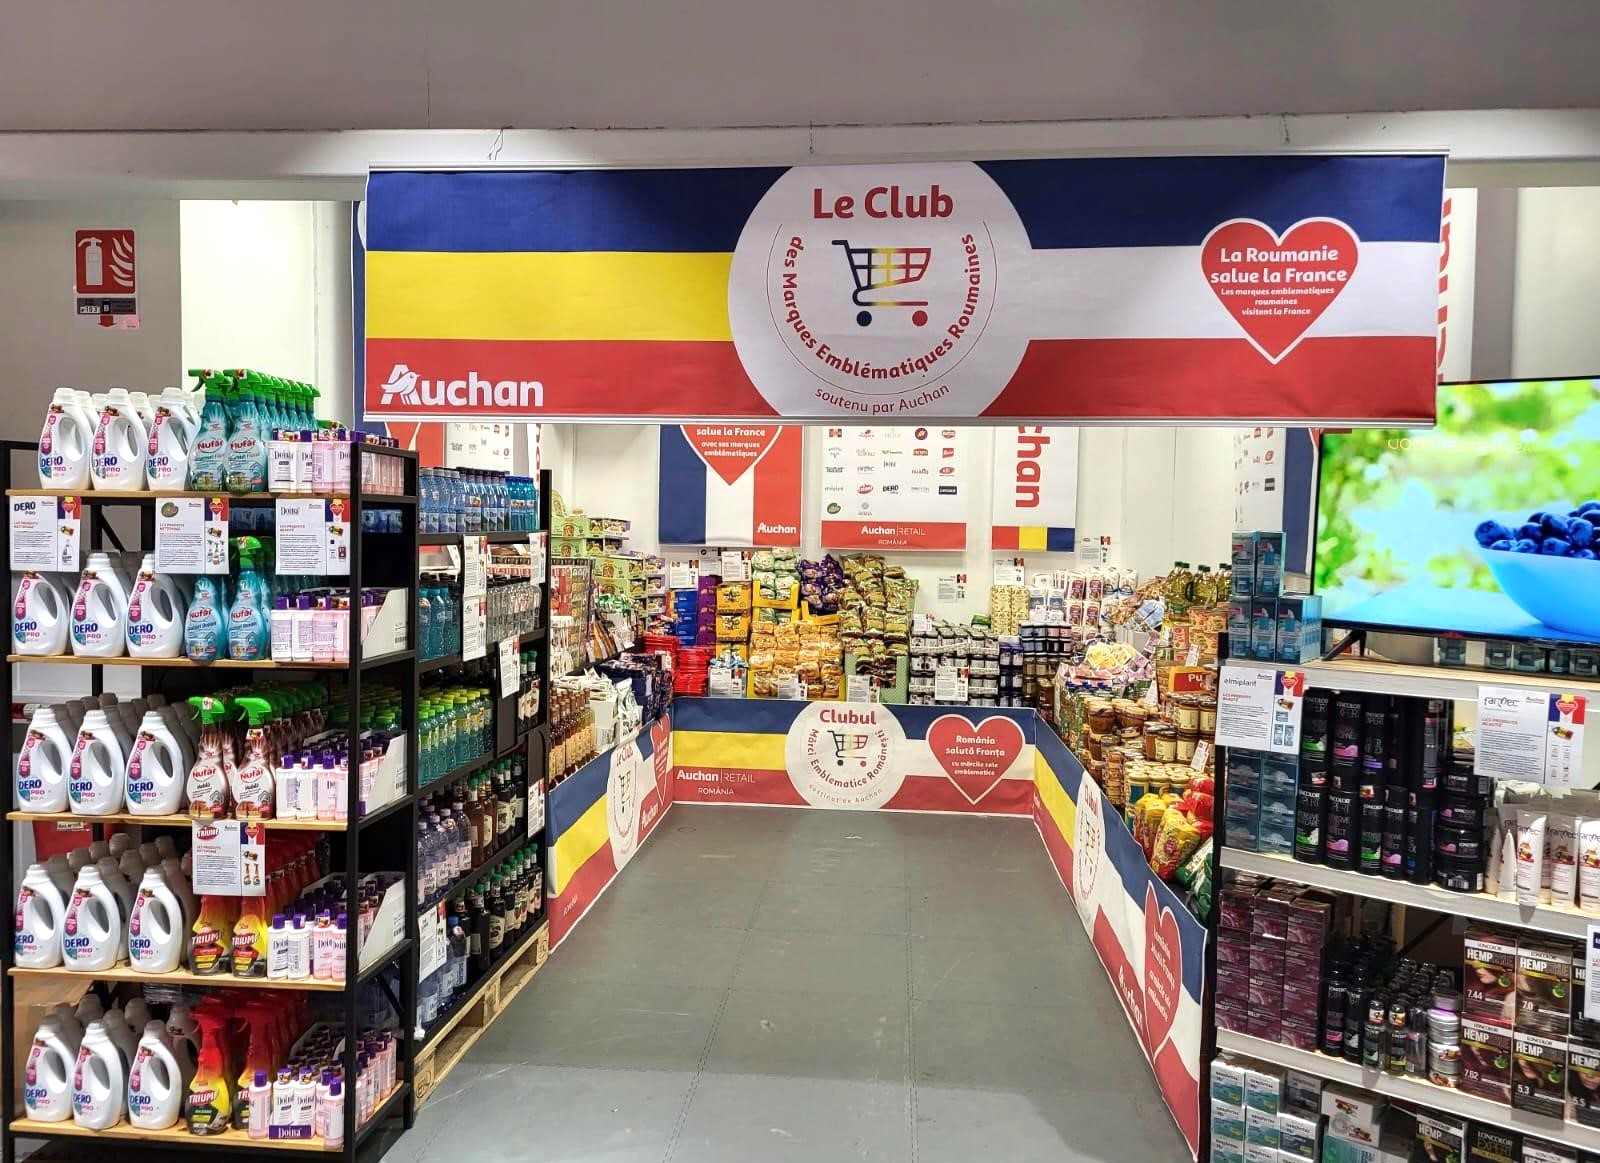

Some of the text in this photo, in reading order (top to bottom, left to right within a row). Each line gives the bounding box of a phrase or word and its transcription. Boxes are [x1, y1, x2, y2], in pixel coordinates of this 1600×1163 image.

[814, 185, 954, 219] Le Club
[1220, 245, 1338, 263] La Roumanie
[1210, 267, 1348, 284] salue la France
[1221, 288, 1234, 296] Les
[1235, 288, 1269, 298] marques
[782, 233, 981, 380] des Marques Emblématiques Roumaines
[1254, 297, 1298, 306] roumaines
[1241, 307, 1274, 316] visitent
[1284, 307, 1311, 316] France
[380, 364, 544, 408] Auchan
[815, 385, 950, 416] soutenu par Auchan
[696, 426, 766, 437] salue la France
[41, 455, 63, 467] DERO
[94, 456, 118, 467] DERO
[148, 456, 169, 467] DERO
[14, 501, 36, 511] DERO
[757, 522, 797, 534] Auchan
[861, 526, 926, 536] Auchan RETAIL
[15, 621, 37, 633] DERO
[74, 623, 98, 634] DERO
[129, 623, 153, 635] DERO
[819, 708, 877, 725] Clubul
[956, 735, 996, 745] România
[945, 746, 975, 755] salută
[676, 769, 756, 783] Auchan RETAIL
[810, 758, 868, 788] Emblematice
[18, 779, 42, 790] DERO
[70, 781, 93, 791] DERO
[128, 781, 154, 792] DERO
[697, 785, 735, 796] ROMÂNIA
[65, 937, 89, 948] DERO
[1467, 989, 1483, 1000] 7.44
[1522, 1000, 1534, 1011] 7.0
[1517, 1084, 1530, 1095] 5.3
[278, 1125, 302, 1138] Doina
